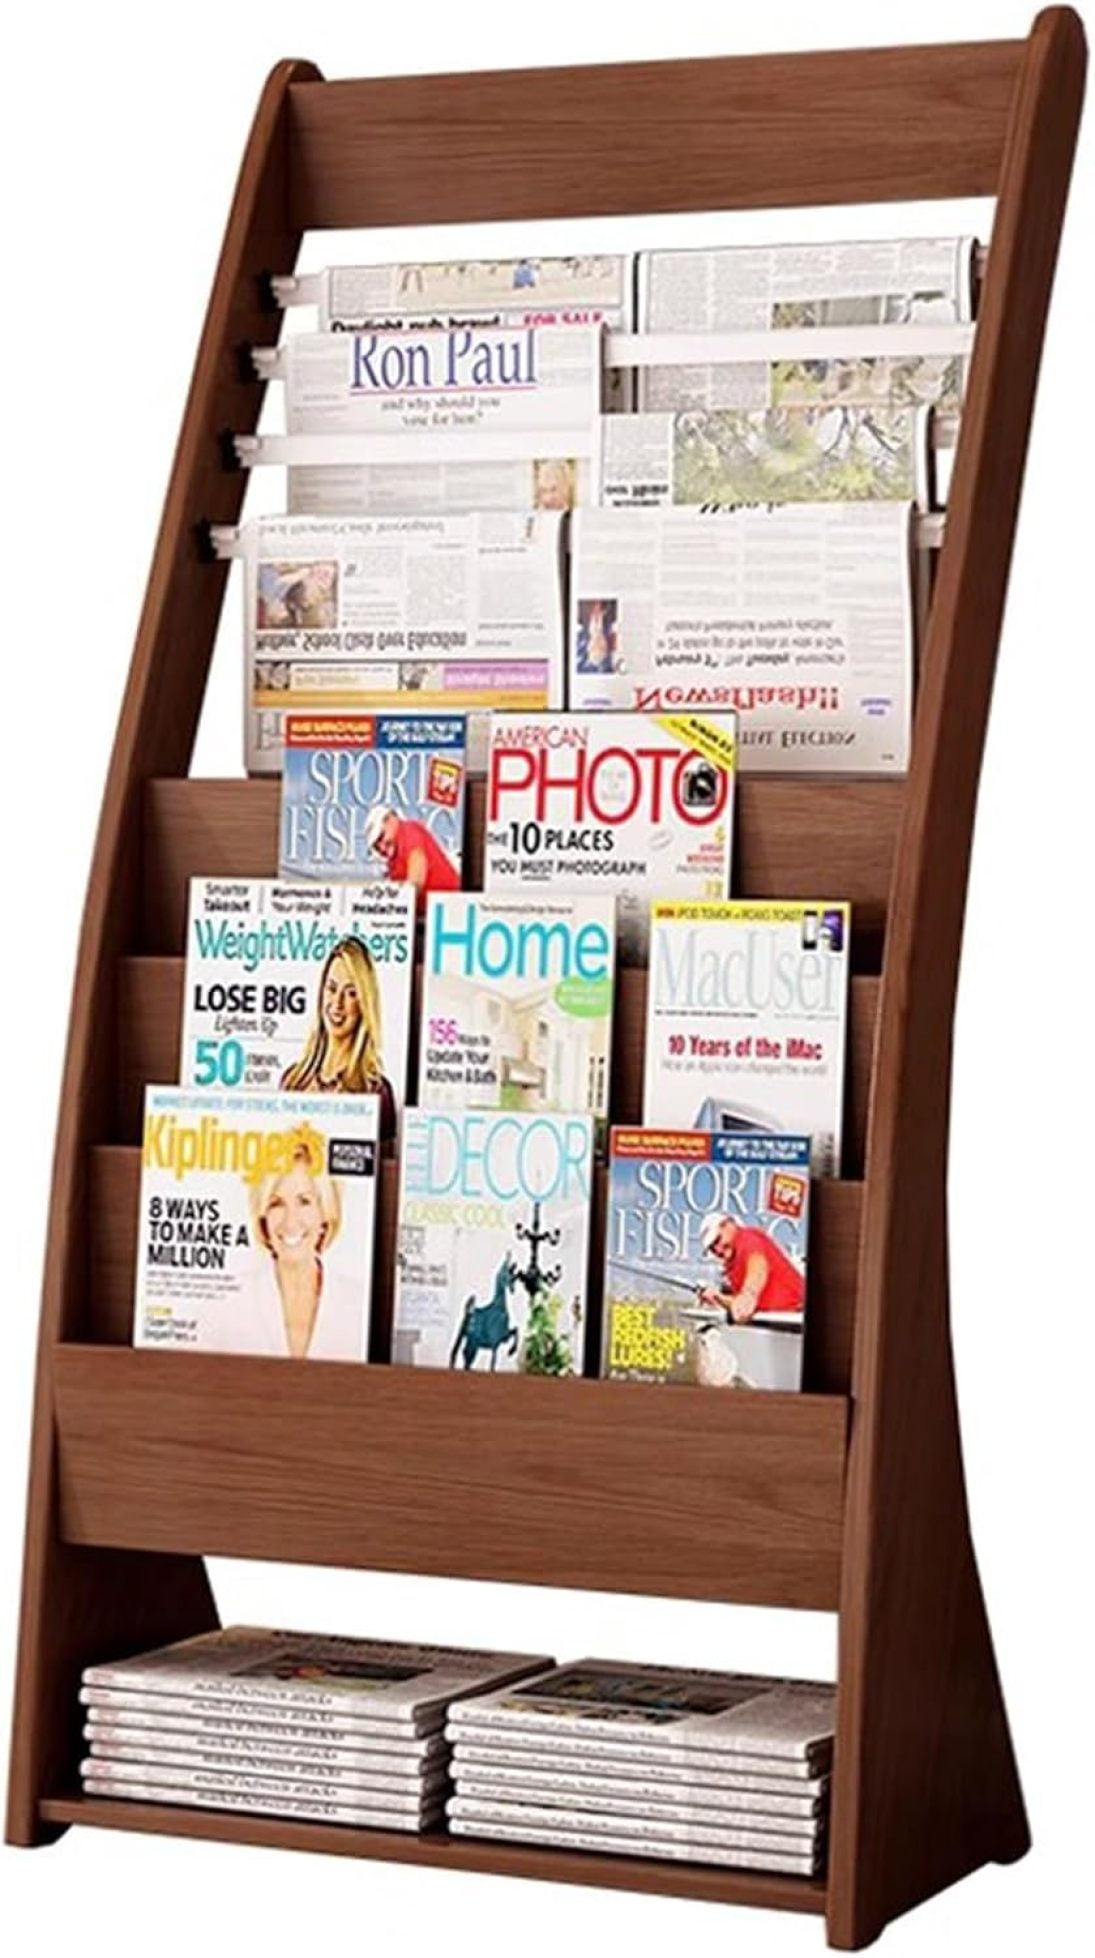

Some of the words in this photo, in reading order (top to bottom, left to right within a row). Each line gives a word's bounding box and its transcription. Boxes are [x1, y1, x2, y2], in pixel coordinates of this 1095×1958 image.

[351, 334, 431, 390] Ron
[444, 329, 538, 387] Paul
[493, 725, 588, 749] AMERICAN
[310, 750, 437, 806] SPORT
[489, 746, 729, 826] PHOTO
[510, 821, 541, 855] 10
[545, 829, 614, 852] PLACES
[491, 860, 517, 873] YOU
[520, 859, 553, 875] MUST
[557, 859, 648, 876] PHOTOGRAPH
[204, 898, 251, 913] Takeout
[432, 903, 610, 980] Home
[654, 928, 843, 1013] MacUser
[194, 984, 257, 1014] LOSE
[263, 985, 306, 1015] BIG
[194, 1038, 244, 1087] 50
[668, 1034, 686, 1056] 10
[689, 1035, 732, 1058] Years
[735, 1036, 752, 1058] of
[756, 1037, 782, 1060] the
[786, 1038, 824, 1062] iMac
[427, 1116, 590, 1201] DECOR
[638, 1160, 771, 1214] SPORT
[149, 1196, 163, 1219] 8
[166, 1199, 221, 1222] WAYS
[149, 1221, 175, 1242] TO
[176, 1222, 232, 1248] MAKE
[235, 1226, 250, 1248] A
[147, 1246, 226, 1270] MILLION
